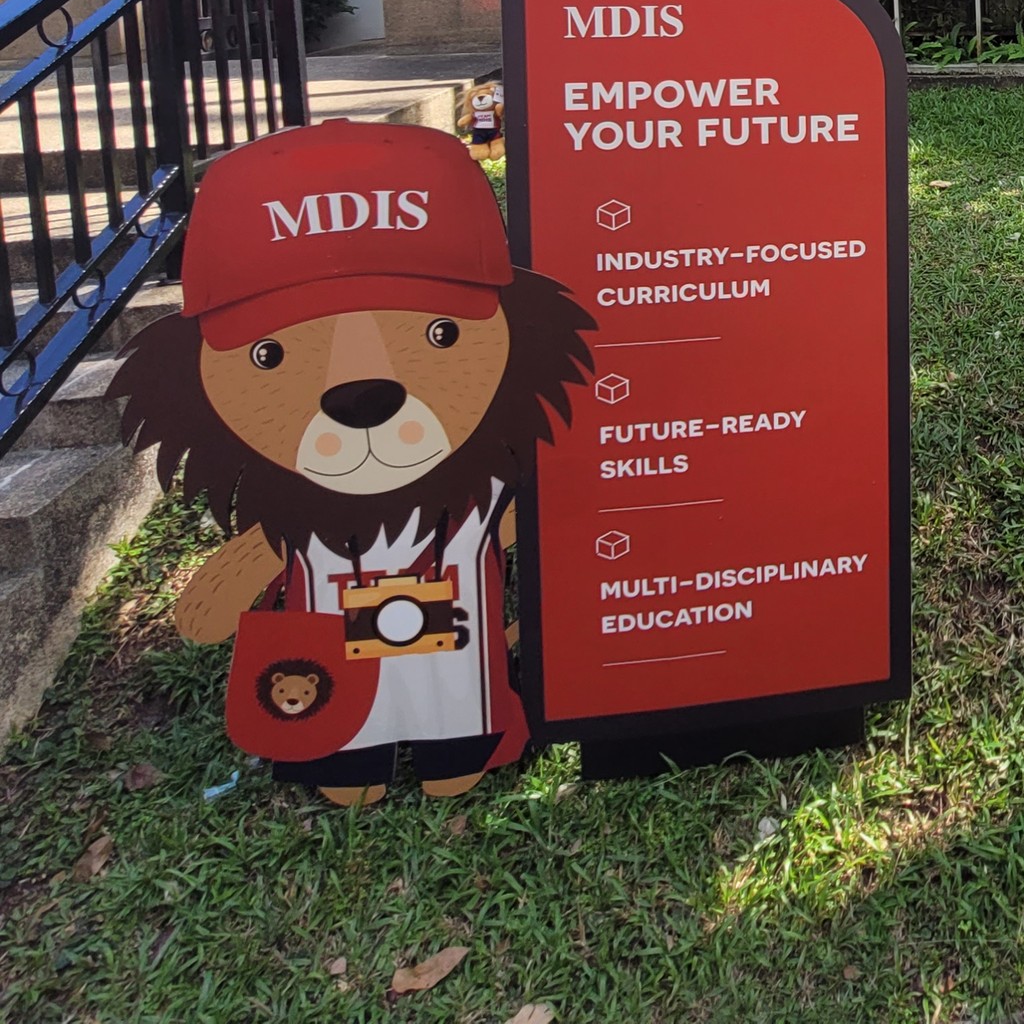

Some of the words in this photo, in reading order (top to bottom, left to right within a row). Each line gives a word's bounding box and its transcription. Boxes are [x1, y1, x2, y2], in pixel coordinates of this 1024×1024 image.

[563, 4, 684, 39] MDIS
[564, 78, 780, 111] EMPOWER
[564, 119, 683, 151] YOUR
[698, 114, 860, 147] FUTURE
[262, 190, 430, 242] MDIS
[596, 240, 867, 272] INDUSTRY-FOCUSED
[597, 279, 771, 307] CURRICULUM
[600, 410, 807, 445] FUTURE-READY
[600, 454, 689, 480] SKILLS
[600, 553, 868, 600] MULTI-DISCIPLINARY
[601, 600, 754, 634] EDUCATION
